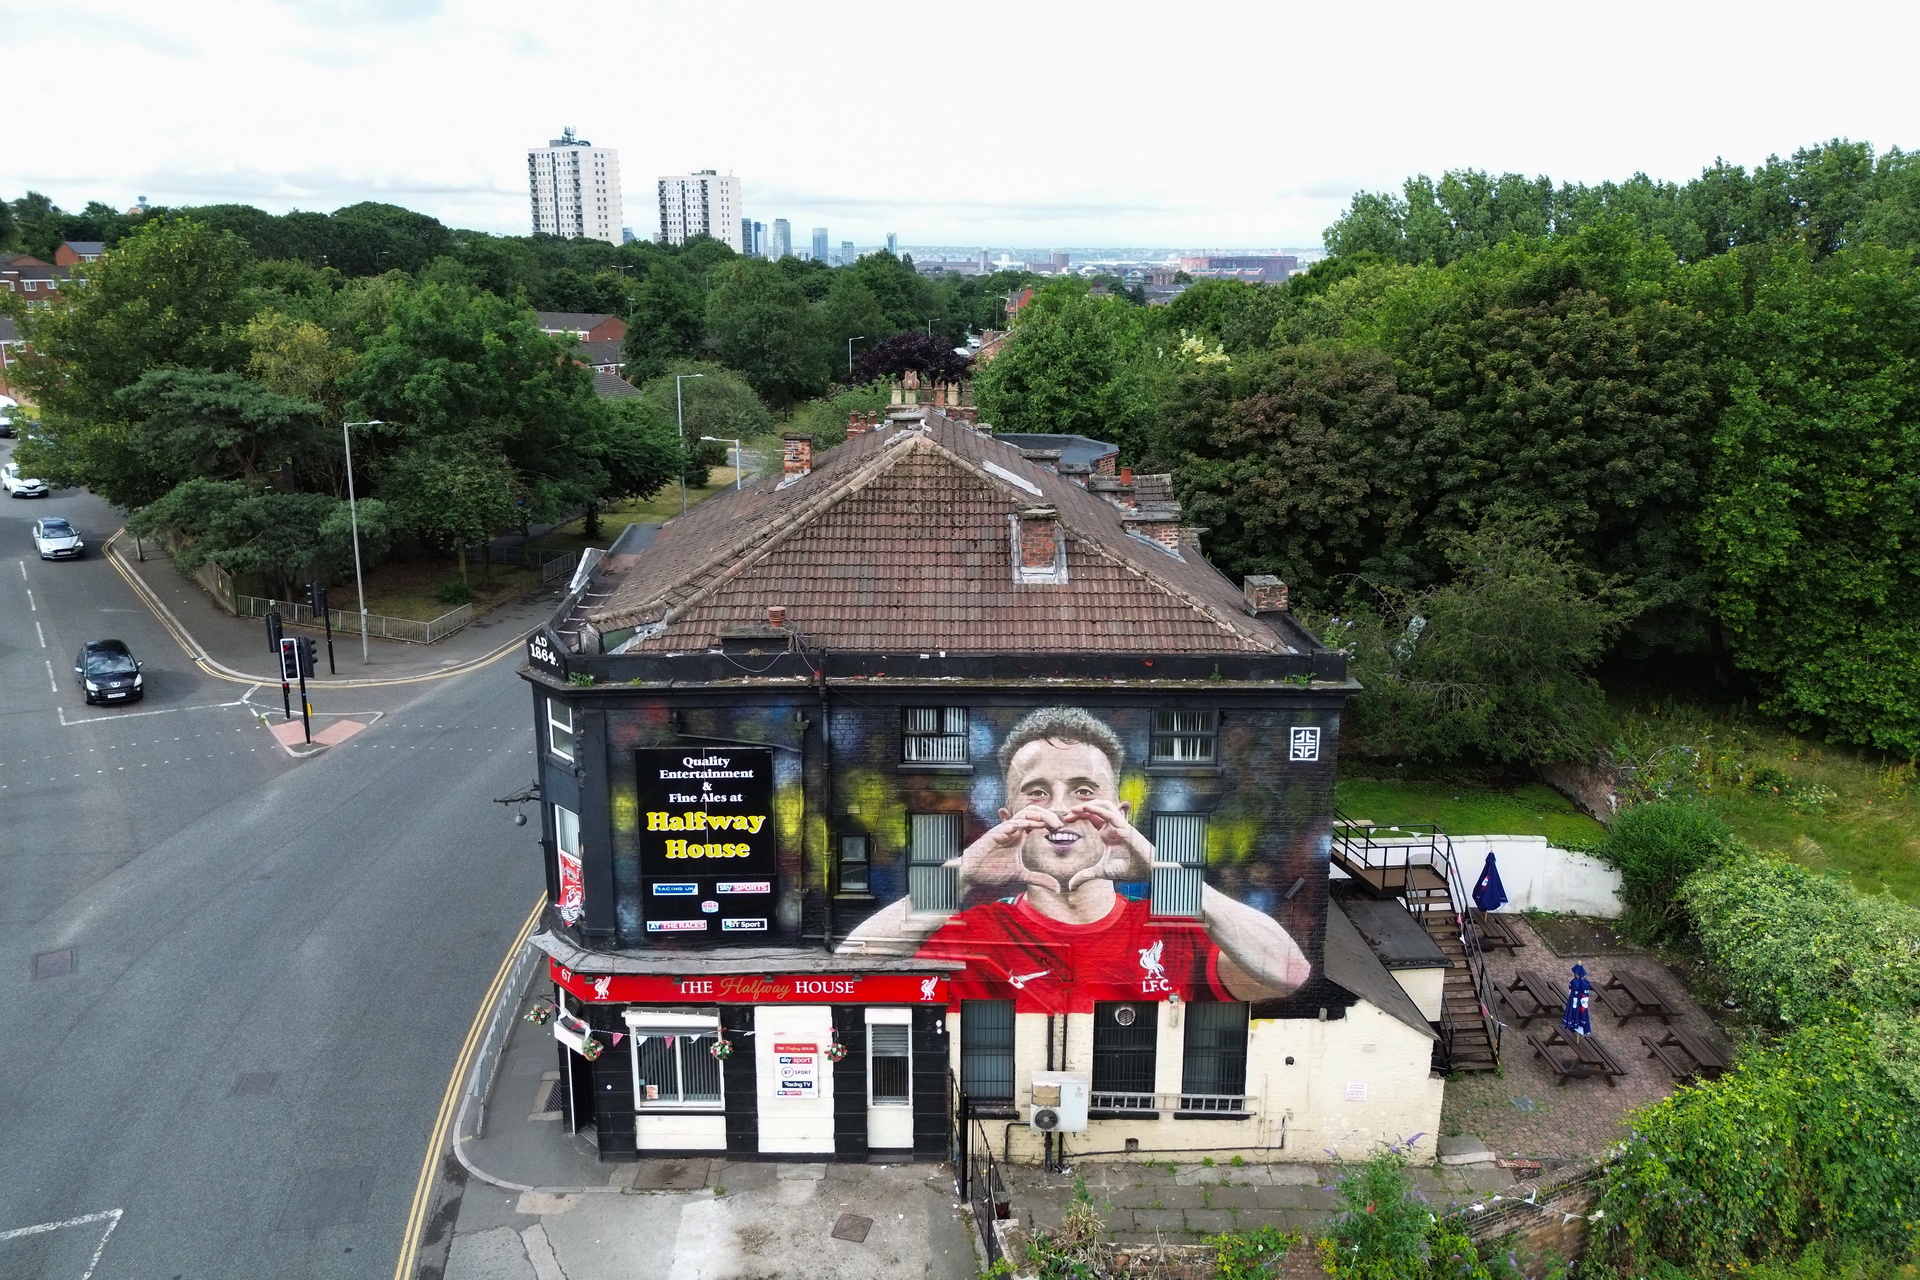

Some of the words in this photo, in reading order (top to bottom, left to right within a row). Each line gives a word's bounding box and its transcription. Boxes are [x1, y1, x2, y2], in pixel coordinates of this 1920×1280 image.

[535, 635, 547, 648] AD
[682, 756, 731, 769] Quality
[659, 768, 754, 779] Entertainment
[702, 781, 712, 791] &
[668, 793, 698, 803] Fine
[699, 792, 727, 802] Ales
[729, 793, 743, 802] at
[646, 811, 766, 834] Halfway
[665, 839, 750, 858] House
[733, 884, 768, 892] SPORTS
[679, 921, 705, 929] RACES
[741, 921, 761, 929] Sport
[561, 969, 572, 983] 67
[680, 981, 713, 994] THE
[717, 976, 791, 1000] Halfway
[795, 981, 855, 994] HOUSE
